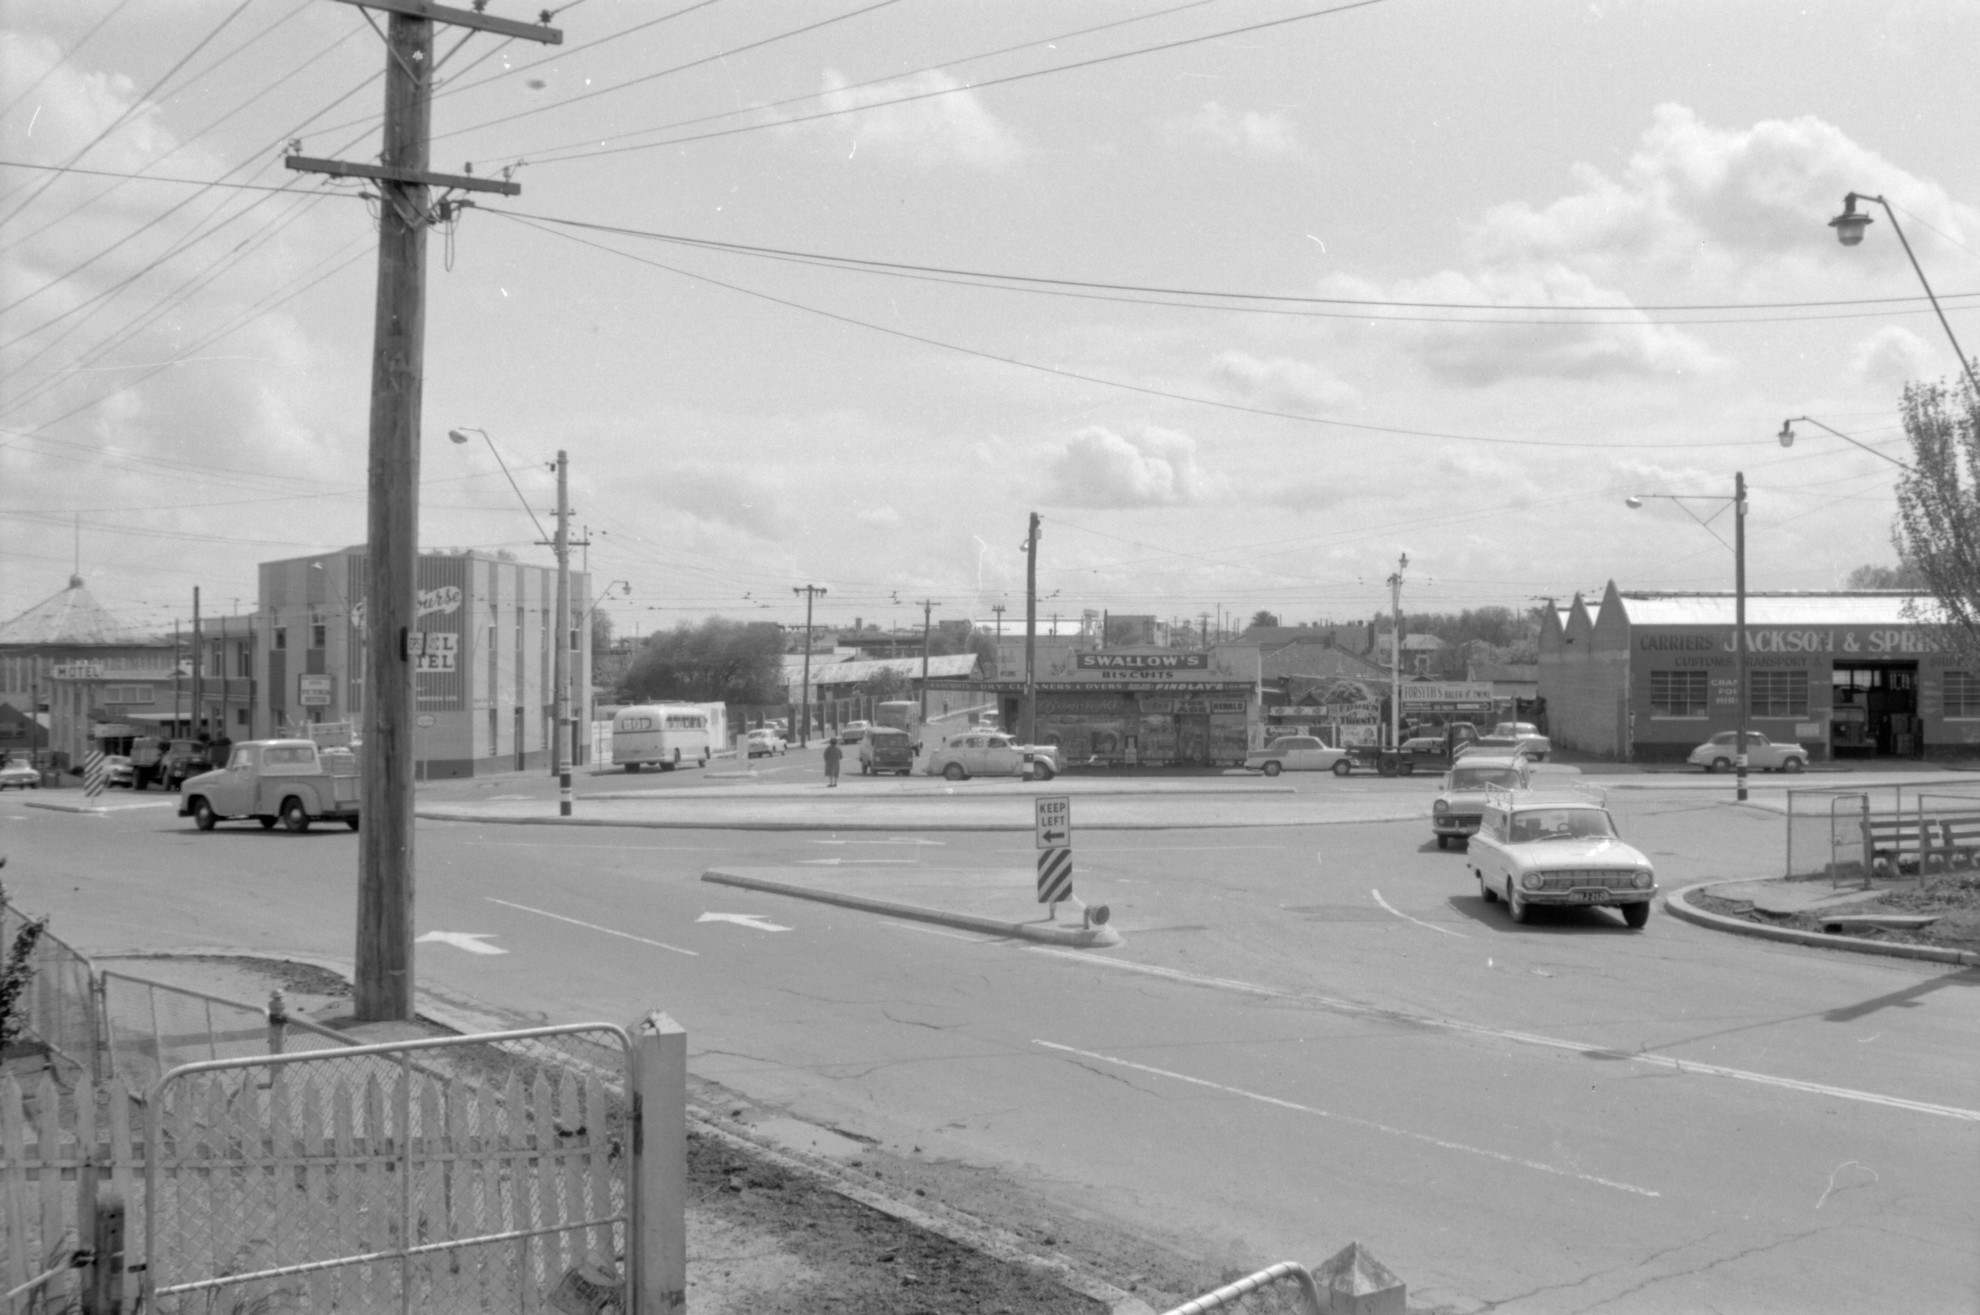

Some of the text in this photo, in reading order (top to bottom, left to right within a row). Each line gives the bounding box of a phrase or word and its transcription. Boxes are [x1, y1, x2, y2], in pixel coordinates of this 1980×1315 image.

[1640, 634, 1713, 651] CARRIERS
[1723, 631, 1834, 652] JACKSON
[1843, 632, 1861, 652] &
[1083, 656, 1199, 667] SWALLOW'S
[1744, 656, 1807, 668] RANSPORT
[58, 666, 99, 677] MOTEL
[1102, 671, 1174, 679] BISCUITS
[1039, 803, 1066, 814] KEEP
[1041, 816, 1065, 827] LEFT
